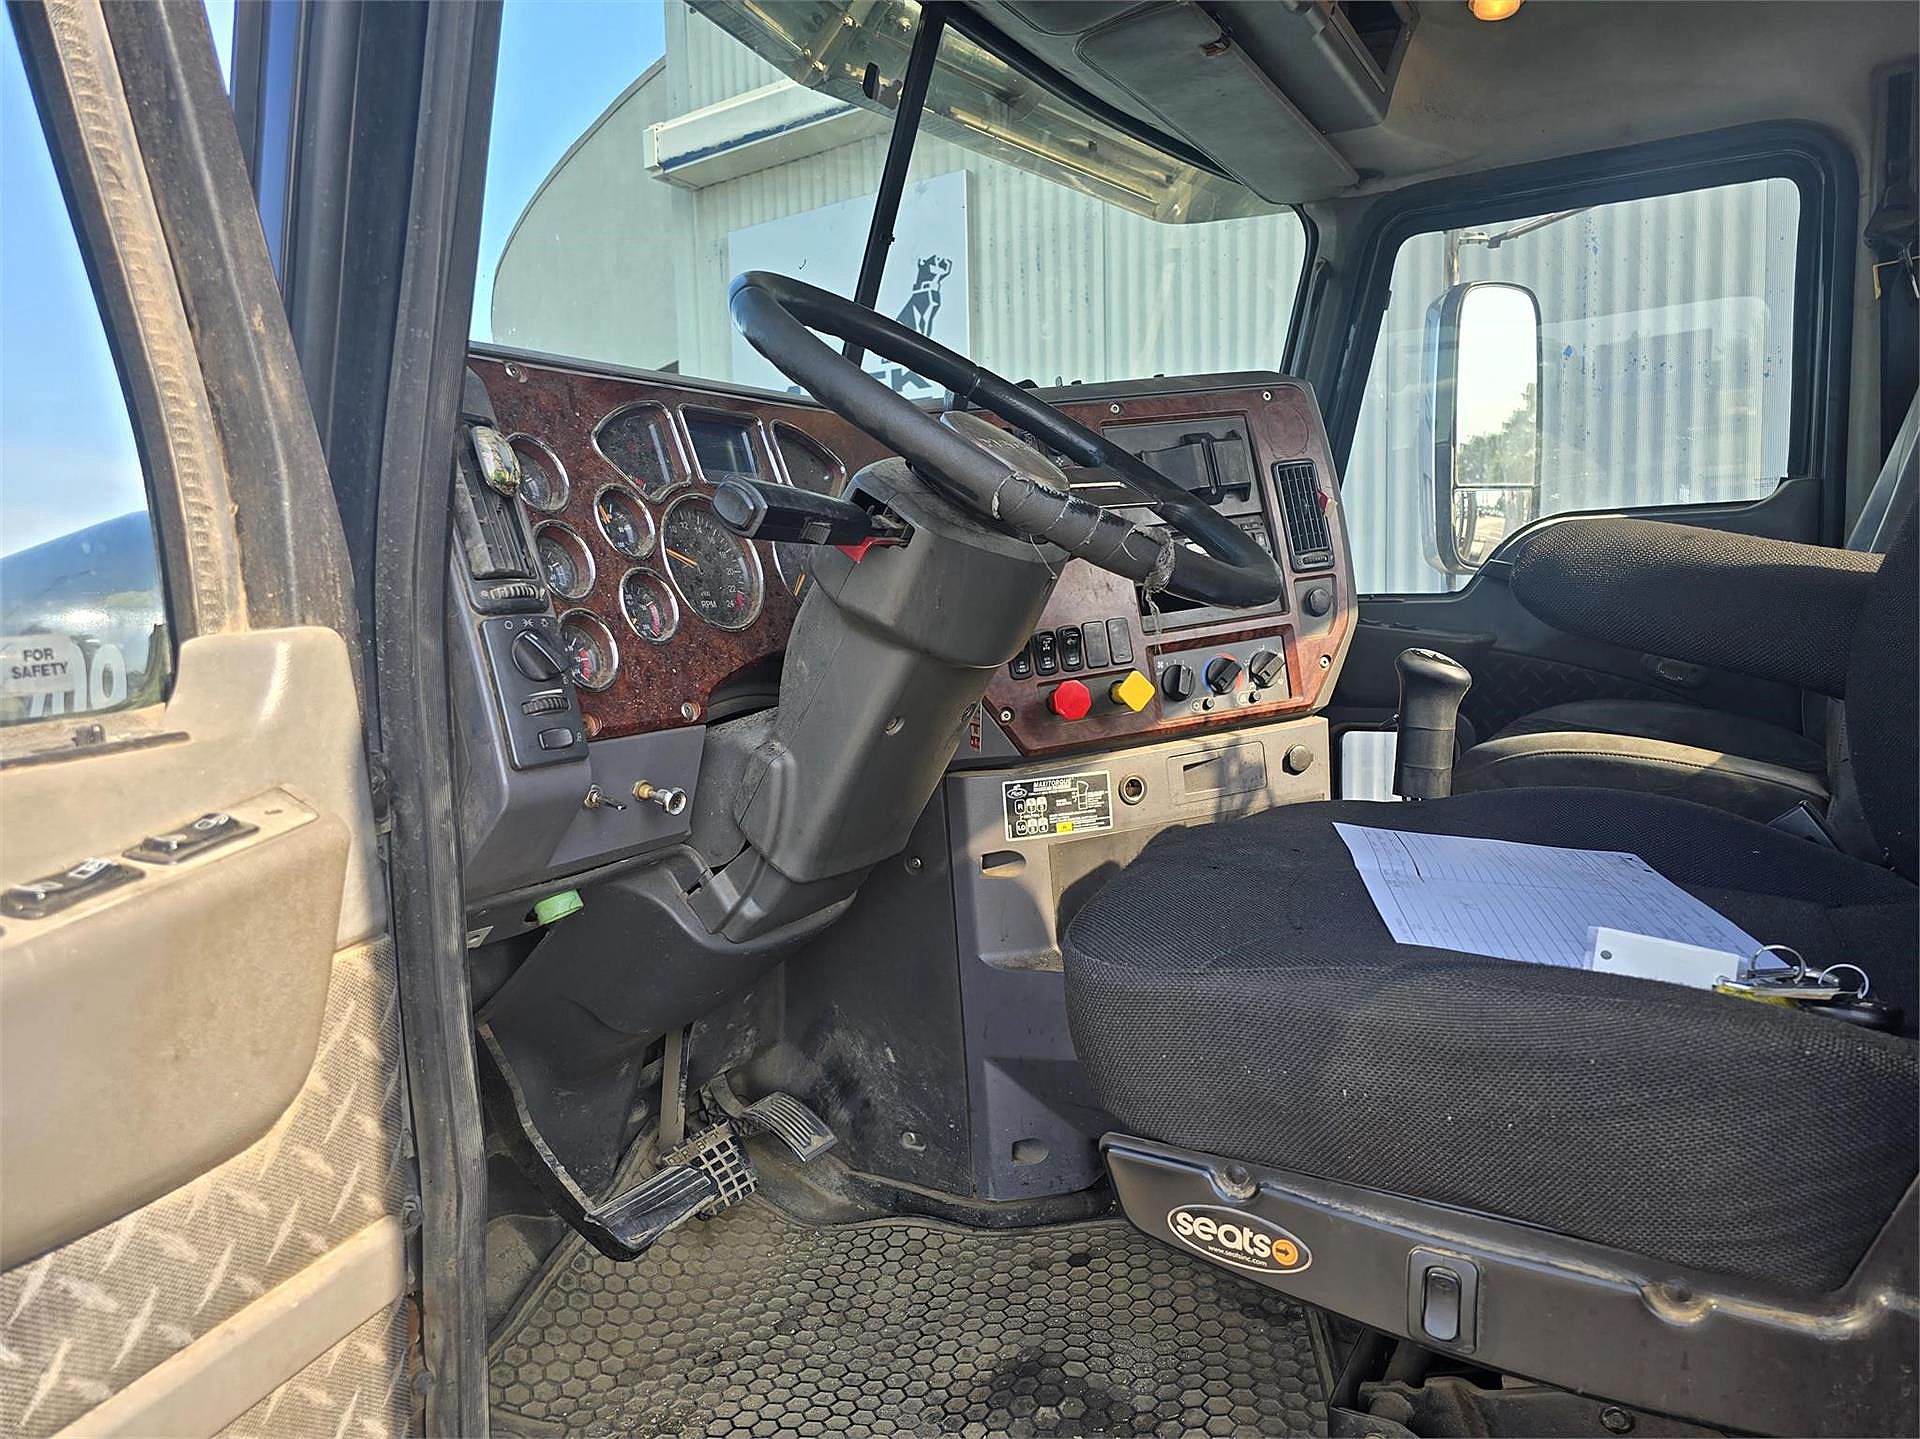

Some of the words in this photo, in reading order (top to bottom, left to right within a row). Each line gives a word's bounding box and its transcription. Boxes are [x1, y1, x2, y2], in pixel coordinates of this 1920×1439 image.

[701, 600, 718, 608] RPM
[23, 647, 54, 662] FOR
[11, 661, 68, 680] SAFETY
[1176, 1212, 1271, 1258] seats
